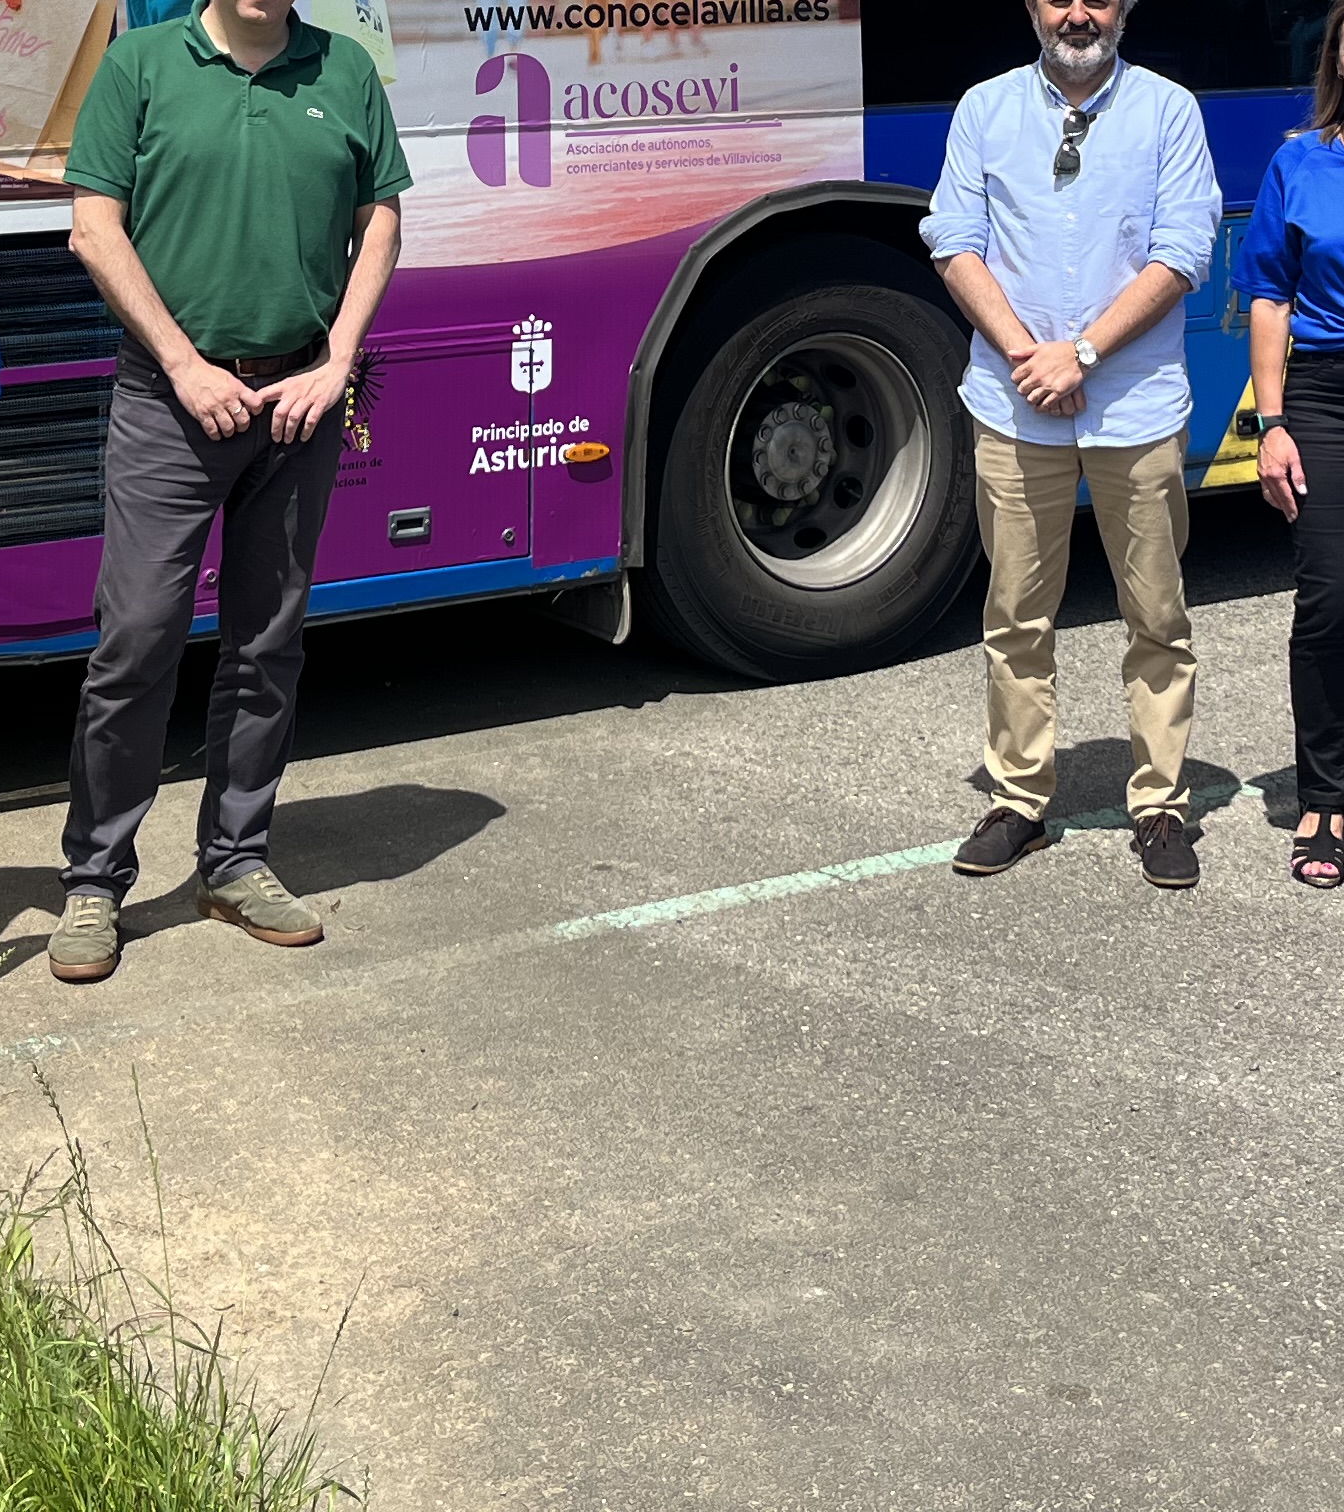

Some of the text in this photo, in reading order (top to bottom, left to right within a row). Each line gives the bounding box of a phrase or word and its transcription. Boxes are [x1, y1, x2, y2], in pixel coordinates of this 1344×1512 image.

[564, 62, 739, 121] acosevi
[566, 137, 713, 156] Asociación de autónomos,
[566, 149, 783, 175] comerciantes y servicios de Villaviciosa
[472, 416, 590, 443] Principado de
[370, 458, 383, 468] de
[469, 437, 580, 475] Asturia
